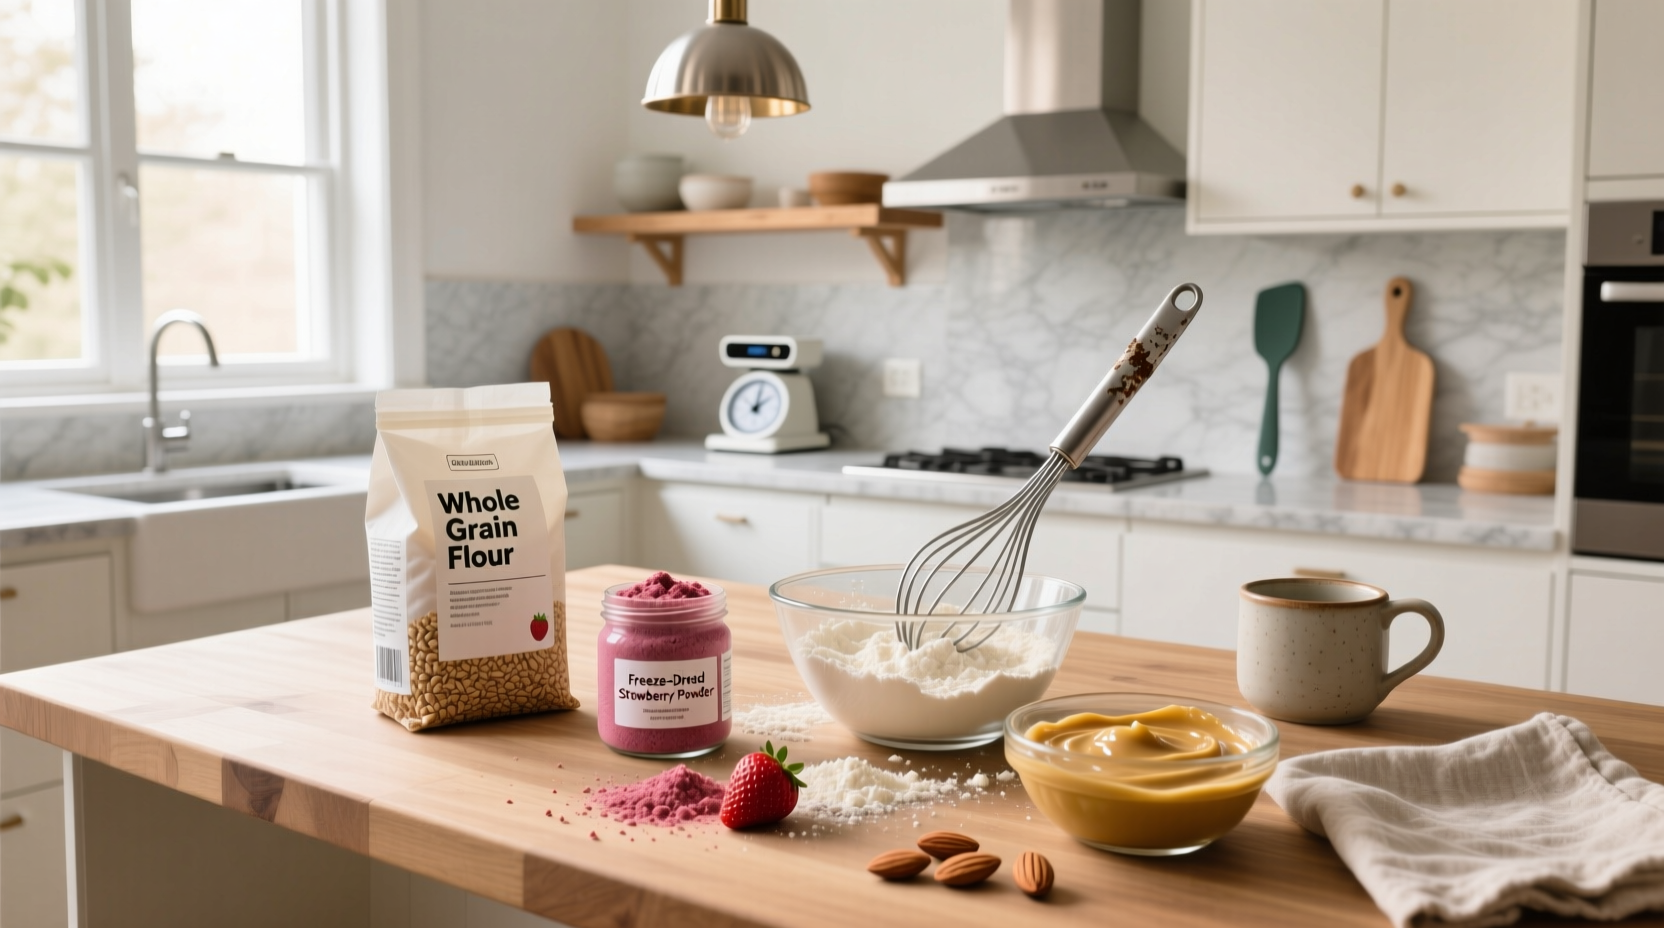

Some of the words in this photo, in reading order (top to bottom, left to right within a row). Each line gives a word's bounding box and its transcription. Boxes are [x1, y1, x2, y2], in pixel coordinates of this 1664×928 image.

[437, 488, 520, 515] Whole
[445, 515, 518, 542] Grain
[448, 545, 514, 570] Flour
[677, 686, 715, 701] Powder
